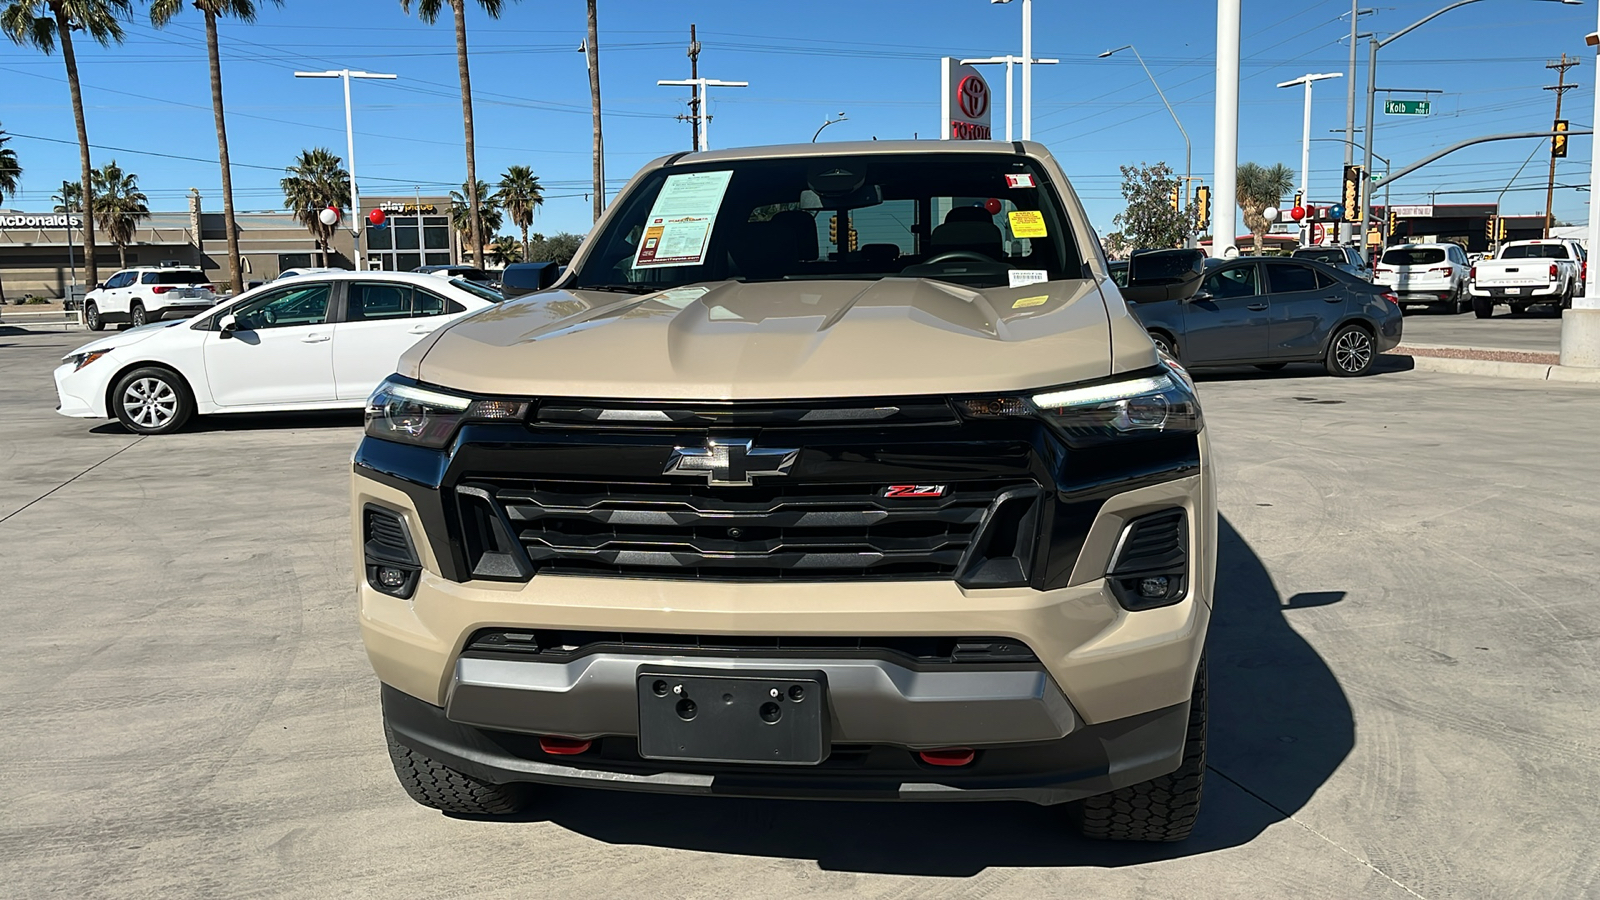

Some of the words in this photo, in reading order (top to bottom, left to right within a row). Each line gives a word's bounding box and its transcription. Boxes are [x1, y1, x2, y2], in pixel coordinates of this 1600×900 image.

[1390, 102, 1406, 113] Kolb
[951, 121, 991, 139] TOYOTA
[379, 201, 433, 212] playplace
[0, 215, 78, 226] McDonalds
[884, 484, 945, 498] Z71
